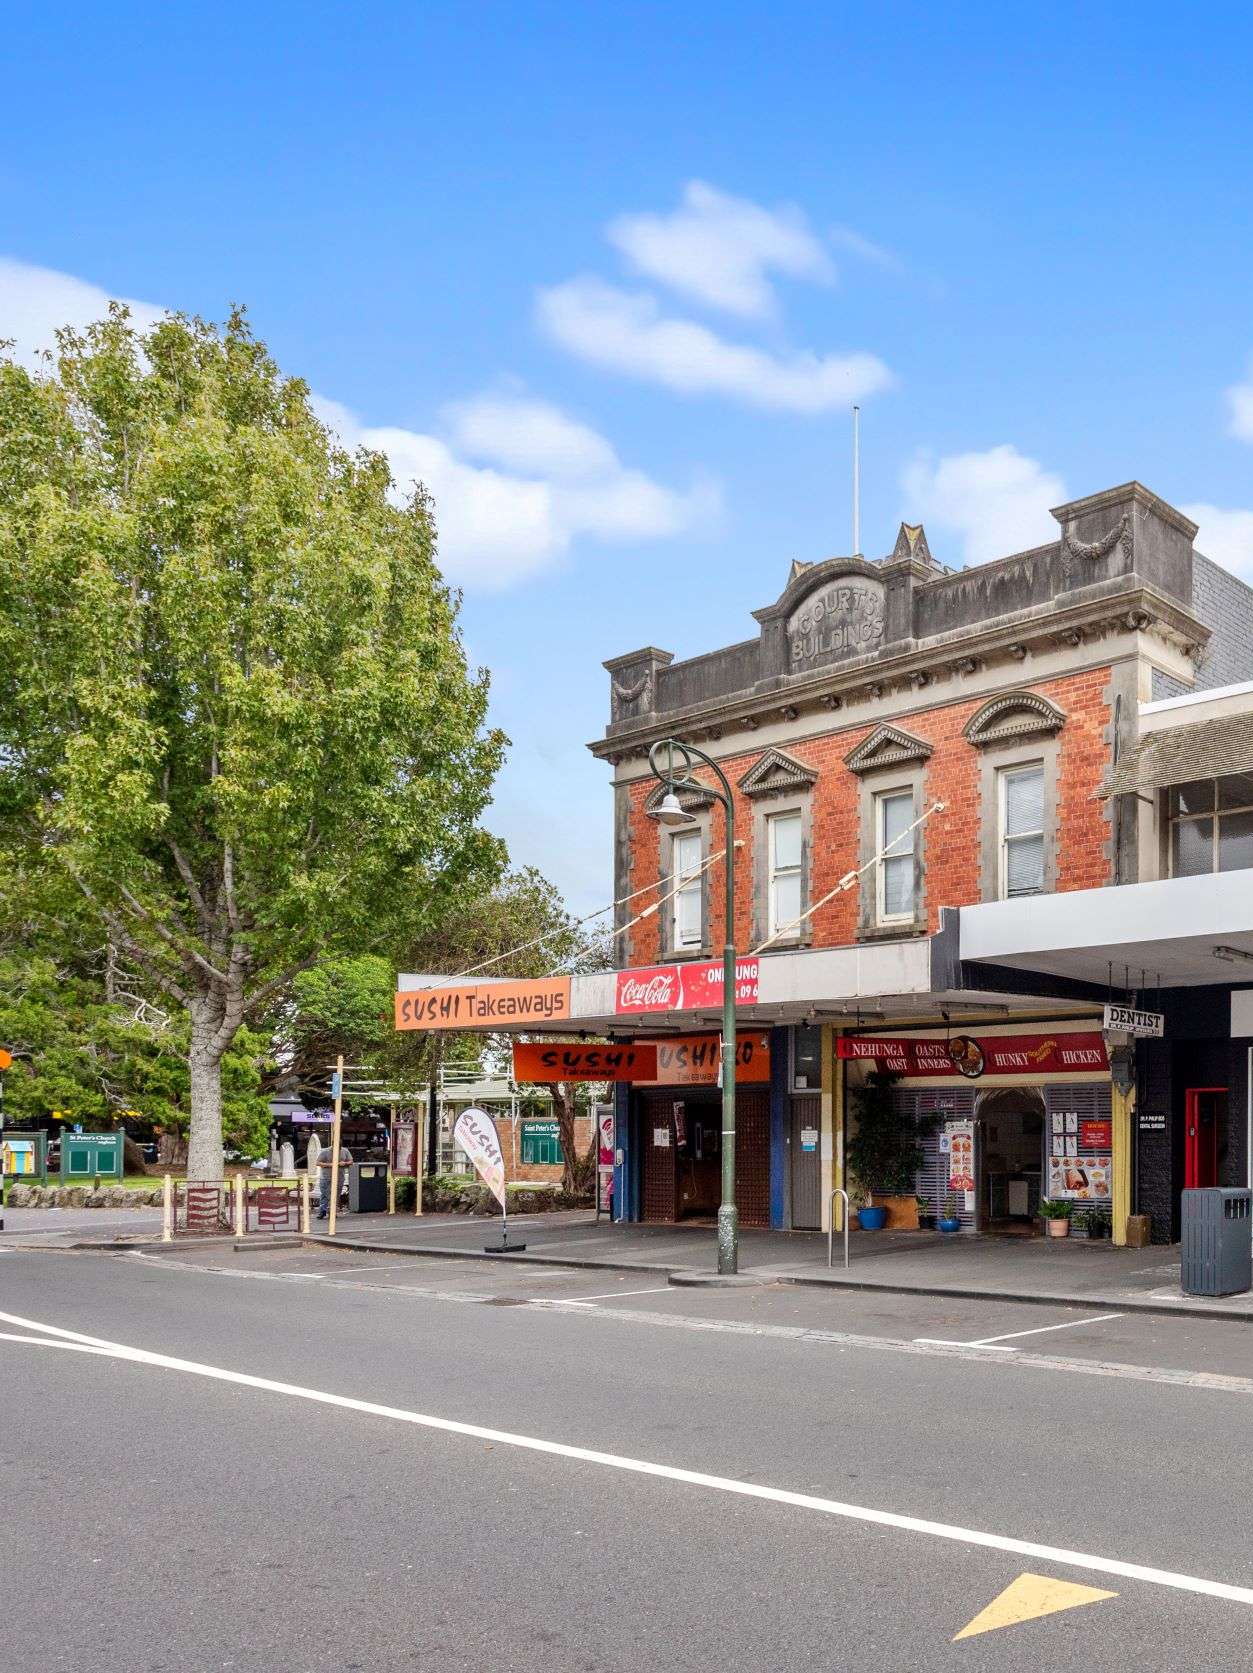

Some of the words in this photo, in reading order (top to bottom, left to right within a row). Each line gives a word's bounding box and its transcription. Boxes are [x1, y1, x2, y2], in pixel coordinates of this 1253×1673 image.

[800, 588, 878, 635] COURTS
[792, 617, 885, 662] BUILDINGS
[402, 994, 460, 1022] SUSHI
[465, 992, 564, 1017] Takeaways
[1110, 1008, 1160, 1028] DENTIST
[541, 1051, 636, 1069] SUSHI
[660, 1041, 717, 1069] USHI
[461, 1114, 501, 1166] SUSHI
